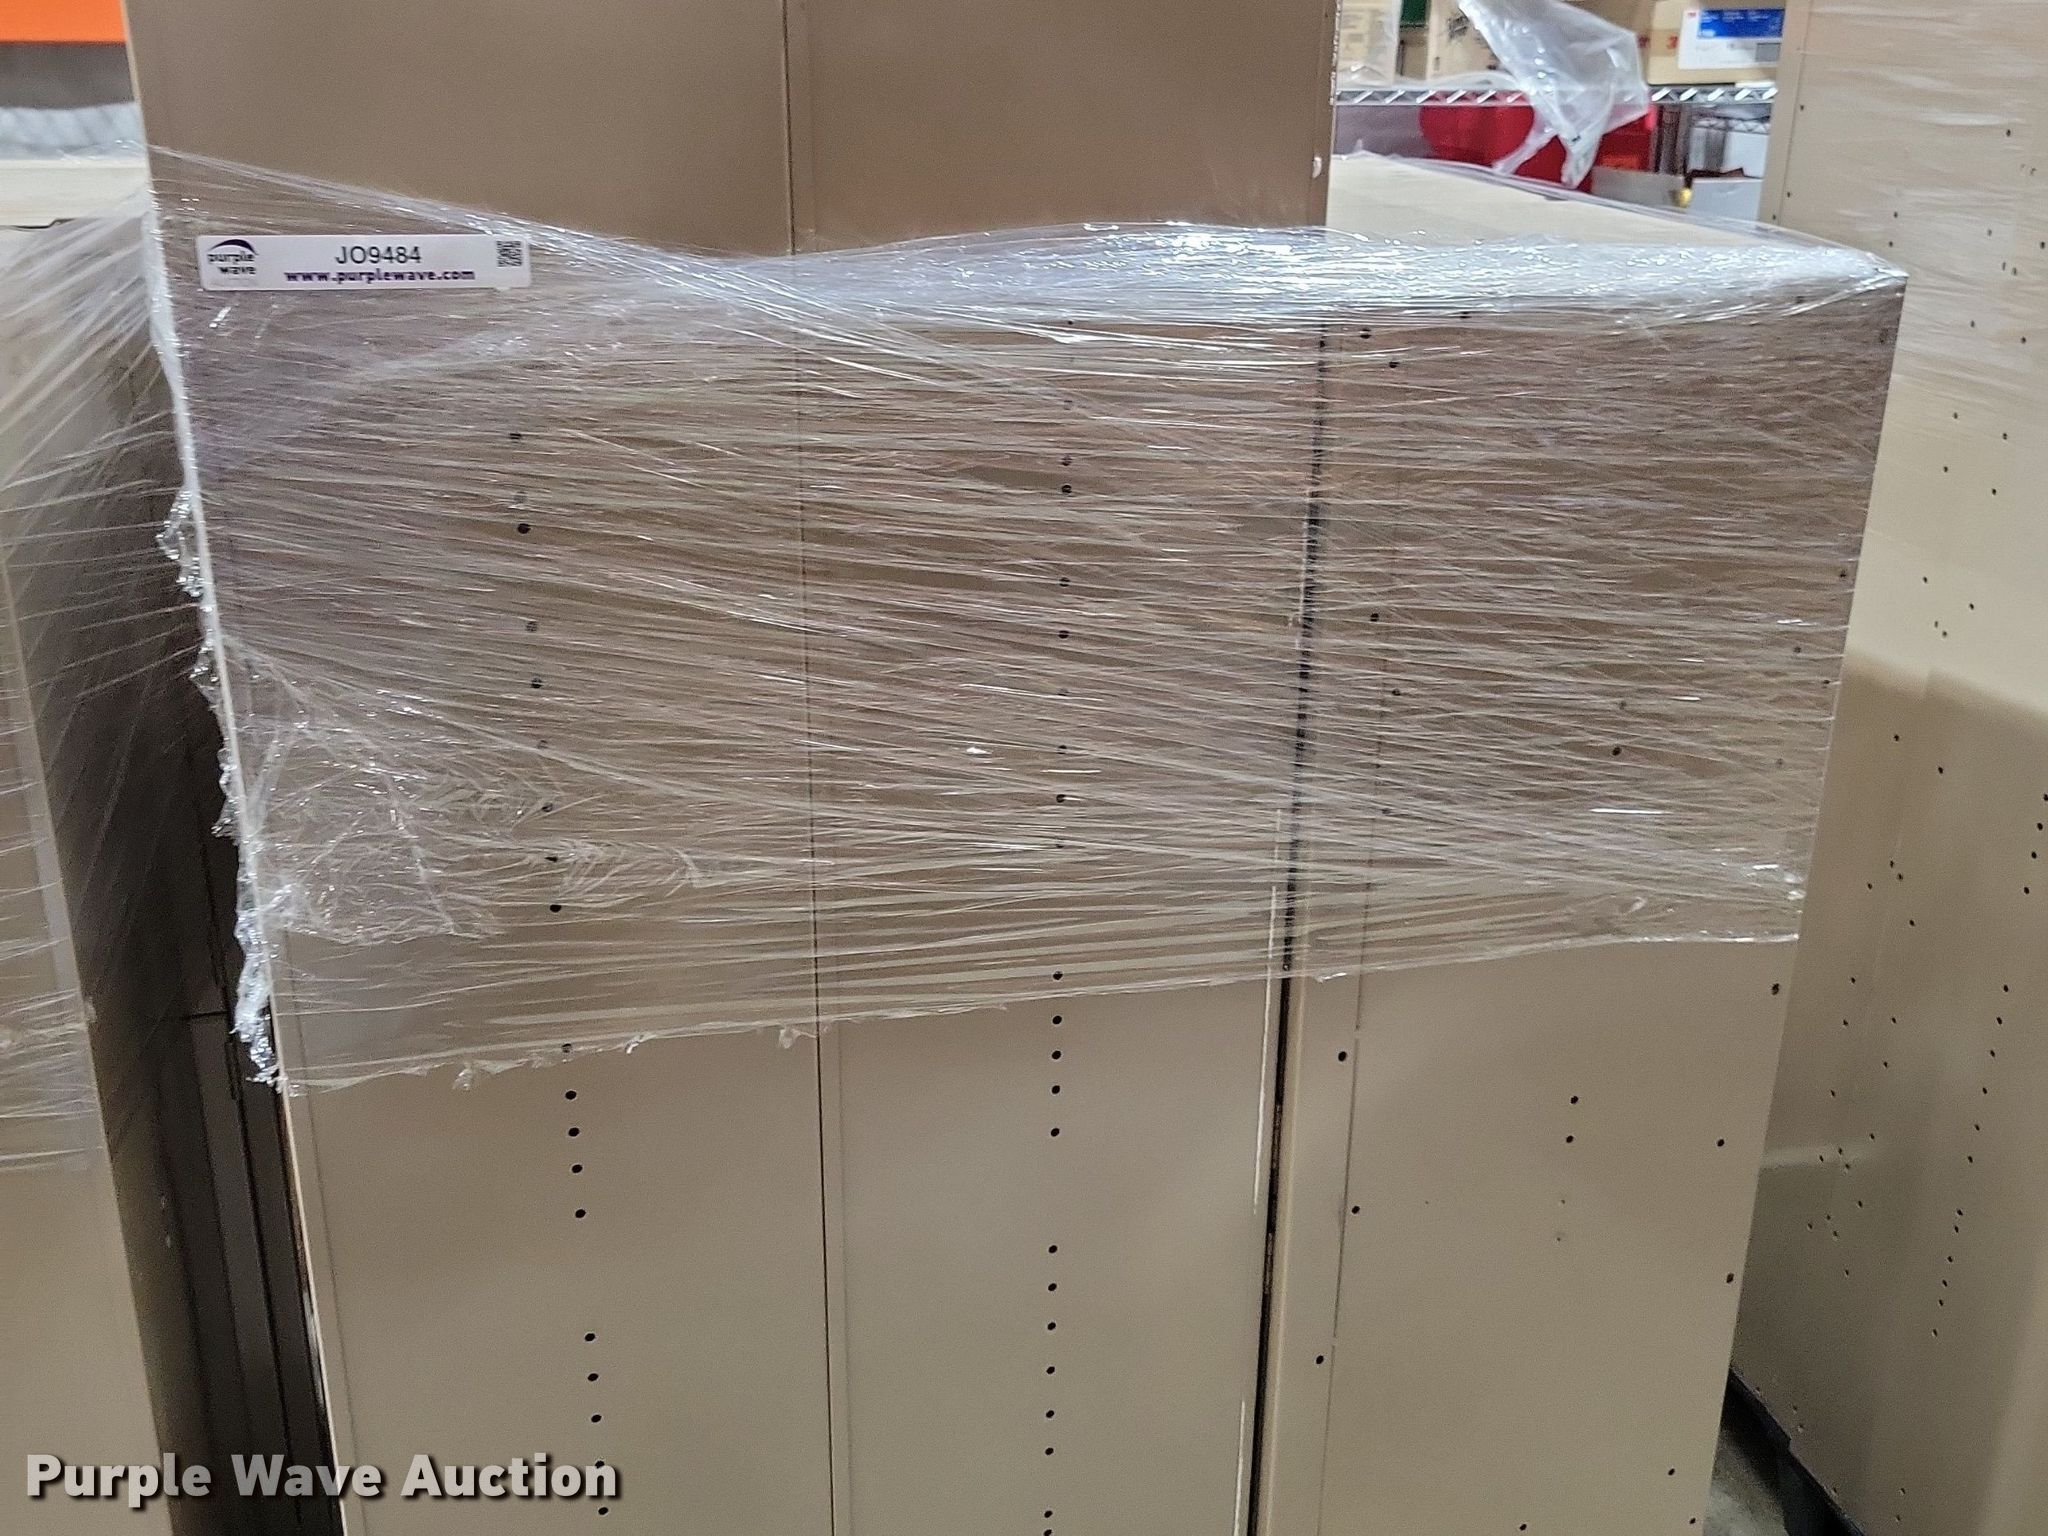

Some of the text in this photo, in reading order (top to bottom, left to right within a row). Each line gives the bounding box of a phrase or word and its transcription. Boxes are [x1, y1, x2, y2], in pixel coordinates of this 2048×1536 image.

[207, 252, 256, 265] purple
[335, 246, 422, 264] JO9484
[219, 264, 257, 275] wave
[284, 269, 476, 284] www.purplewave.com
